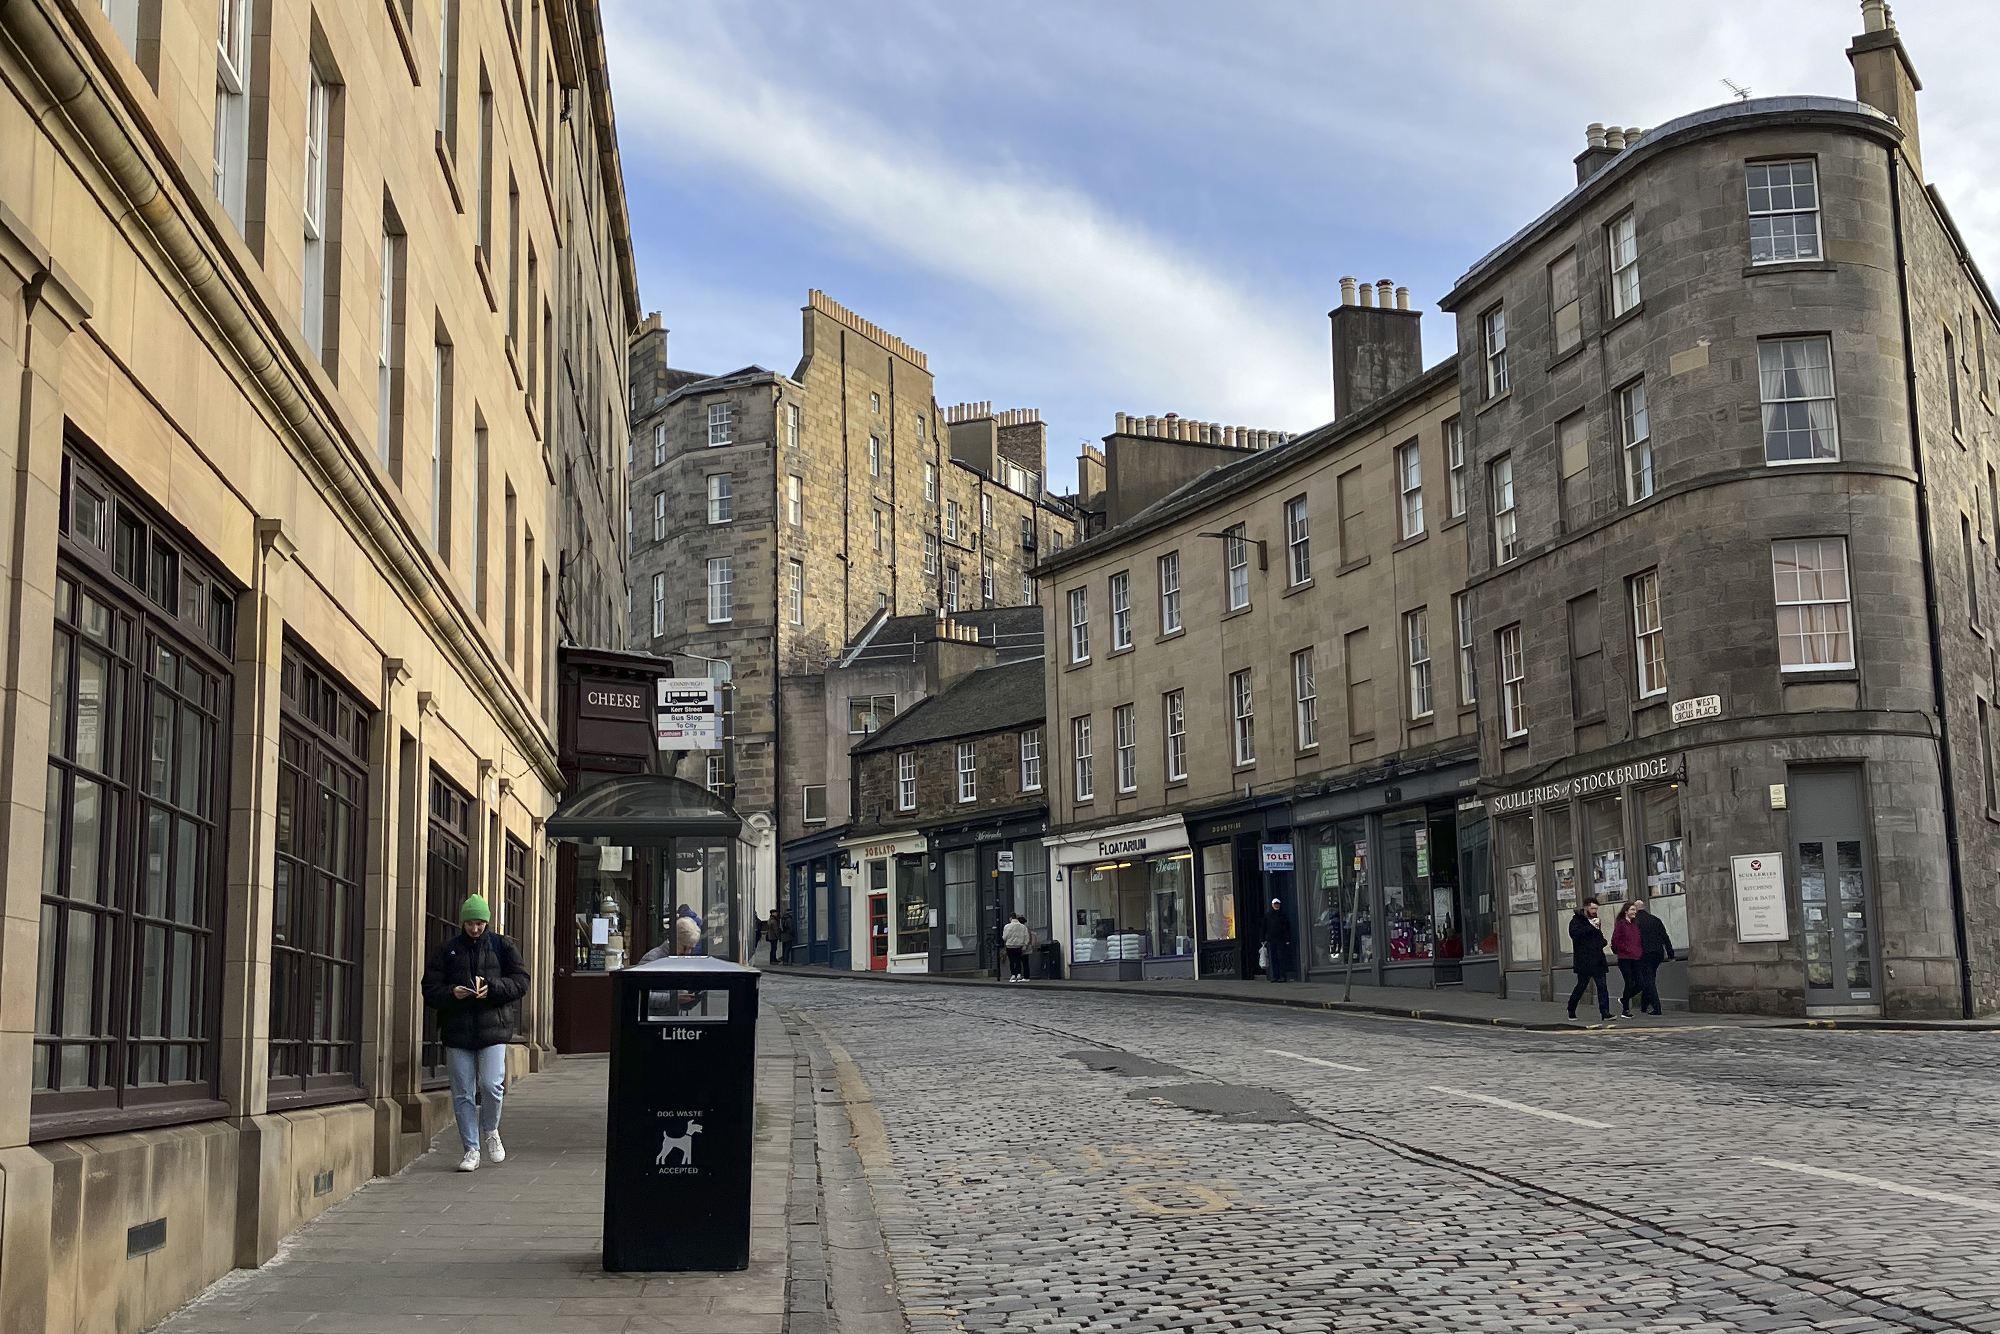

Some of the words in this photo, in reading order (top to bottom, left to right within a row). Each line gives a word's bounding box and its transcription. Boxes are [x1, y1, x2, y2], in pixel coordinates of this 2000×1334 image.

[588, 691, 641, 709] CHEESE
[1675, 700, 1693, 712] NORTH
[1696, 697, 1715, 707] WEST
[1674, 709, 1694, 721] CIRCUS
[1696, 706, 1718, 717] PLACE
[1494, 784, 1560, 812] SCULLERIES
[1561, 780, 1572, 796] of
[1574, 757, 1668, 794] STOCKBRIDGE
[865, 844, 896, 857] JOELATO
[1098, 838, 1147, 856] FLOATARIUM
[1156, 857, 1180, 873] Beauty
[663, 1027, 703, 1040] Litter
